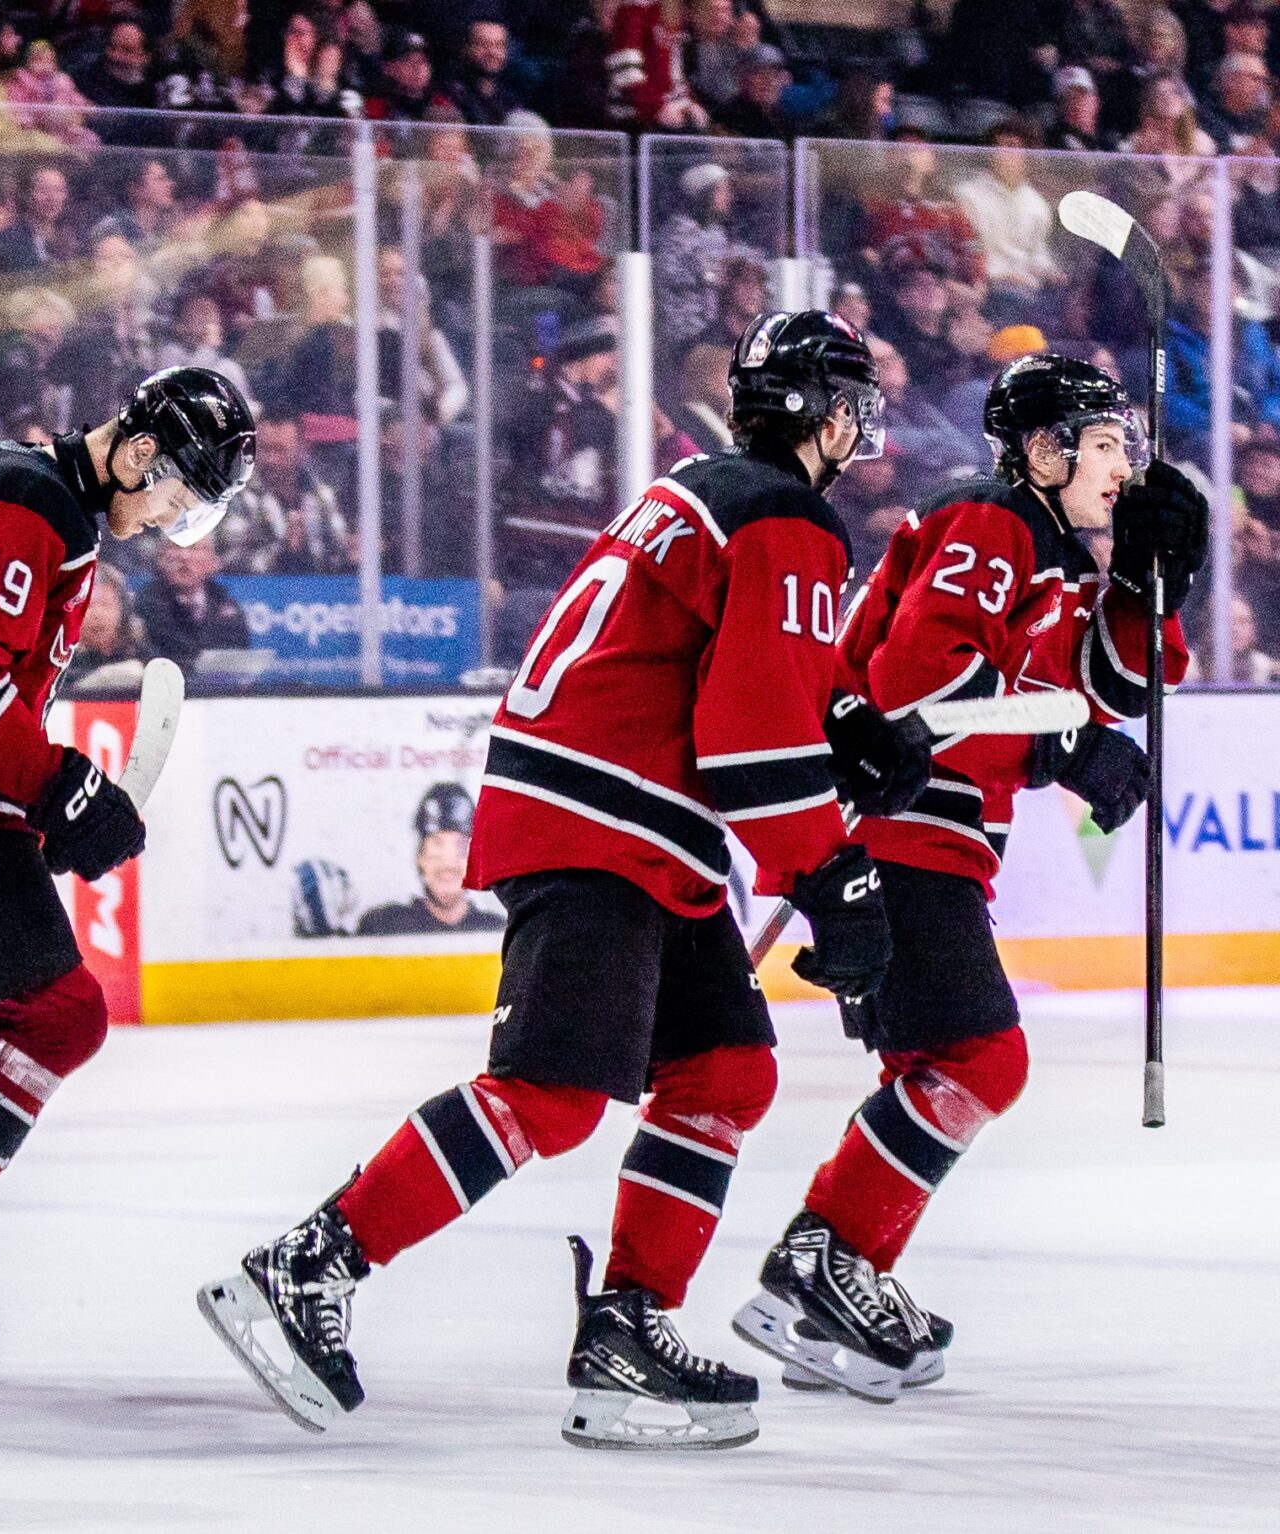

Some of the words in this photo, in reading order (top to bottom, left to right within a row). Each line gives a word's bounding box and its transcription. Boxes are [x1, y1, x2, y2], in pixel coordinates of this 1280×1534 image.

[932, 542, 1014, 615] 23
[781, 574, 836, 645] 10
[65, 765, 103, 821] CC
[842, 867, 881, 903] CC
[594, 1343, 648, 1383] CCM
